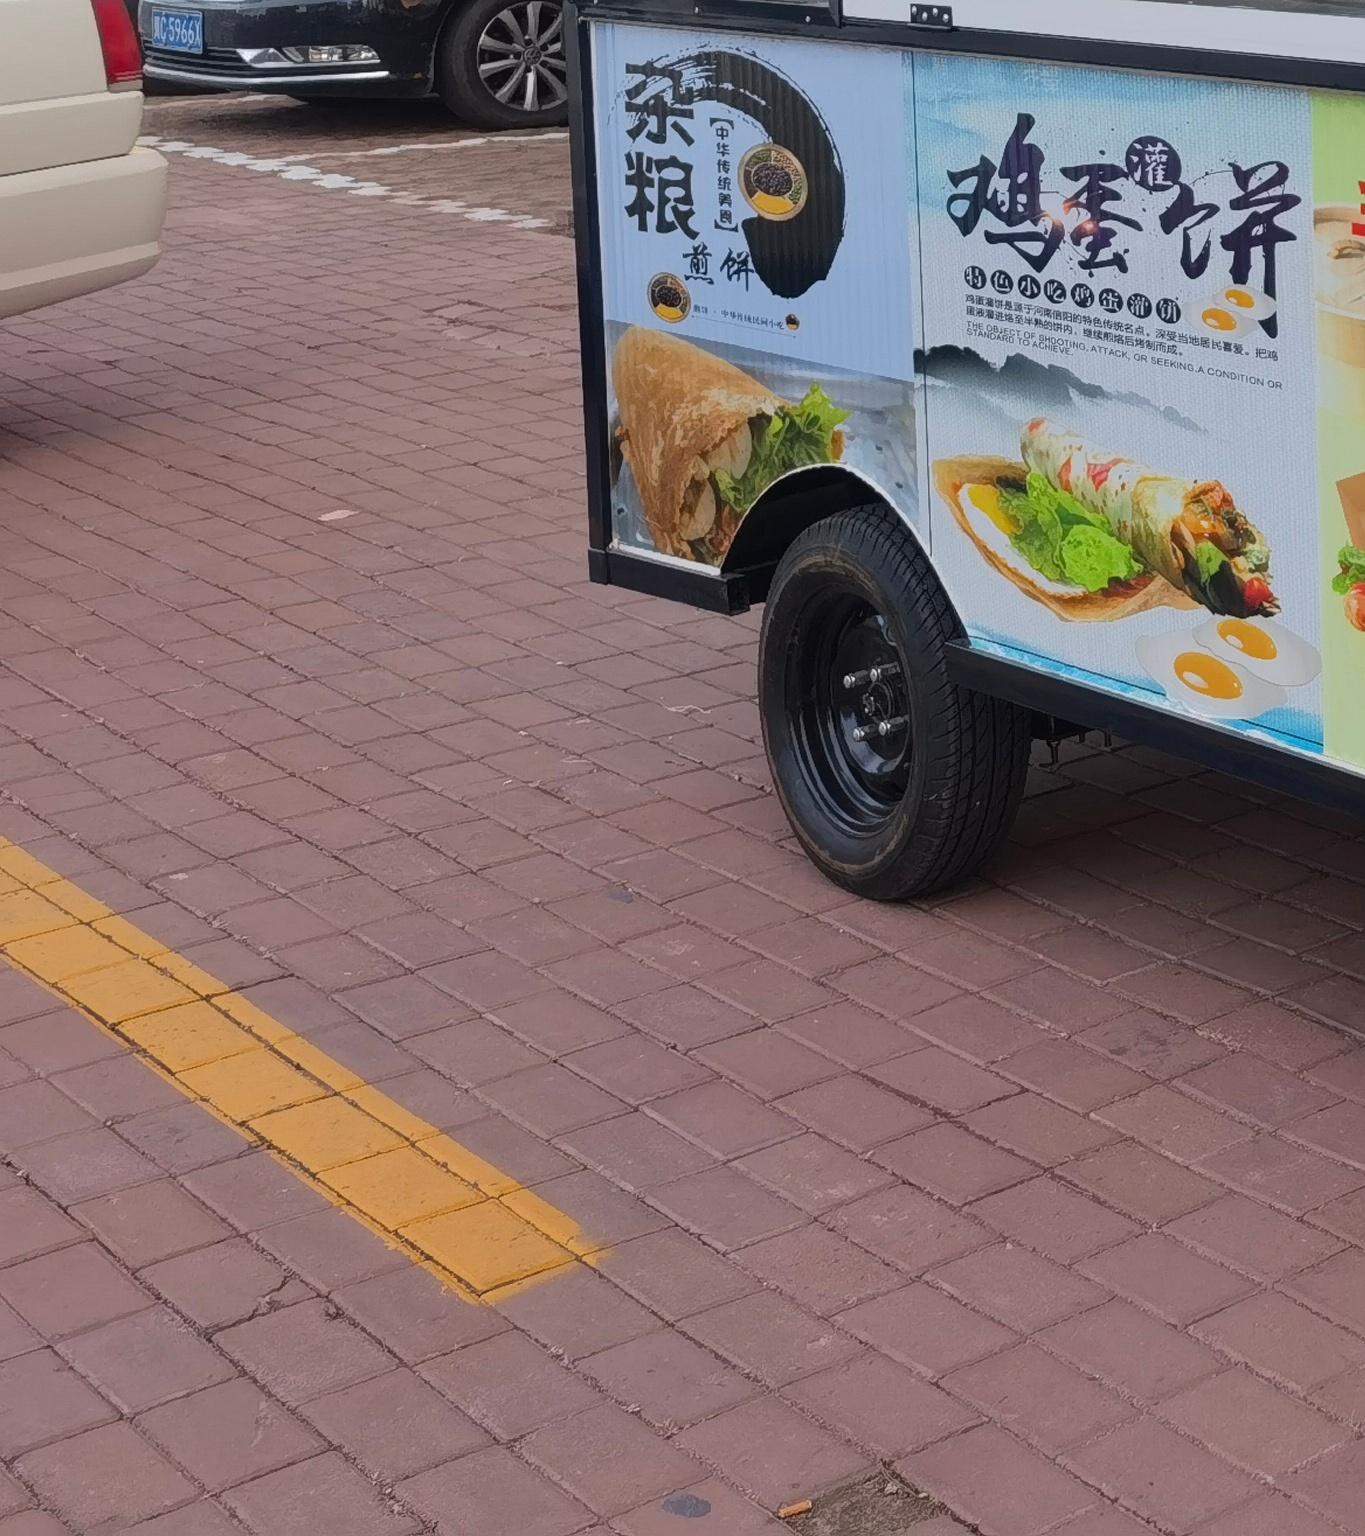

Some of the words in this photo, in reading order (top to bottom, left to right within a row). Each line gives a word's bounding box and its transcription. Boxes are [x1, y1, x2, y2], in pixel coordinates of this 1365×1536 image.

[625, 61, 700, 240] 杂粮
[682, 242, 755, 292] 煎饼
[964, 265, 1182, 324] 特色小吃鸡蛋灌饼
[966, 329, 1014, 343] STANDARD
[1017, 337, 1030, 346] TO
[966, 321, 983, 330] THE
[986, 323, 1022, 336] OBJECT
[1024, 331, 1036, 340] OF
[1133, 353, 1148, 363] OR
[1207, 367, 1265, 386] CONDITION
[1267, 380, 1282, 390] OR
